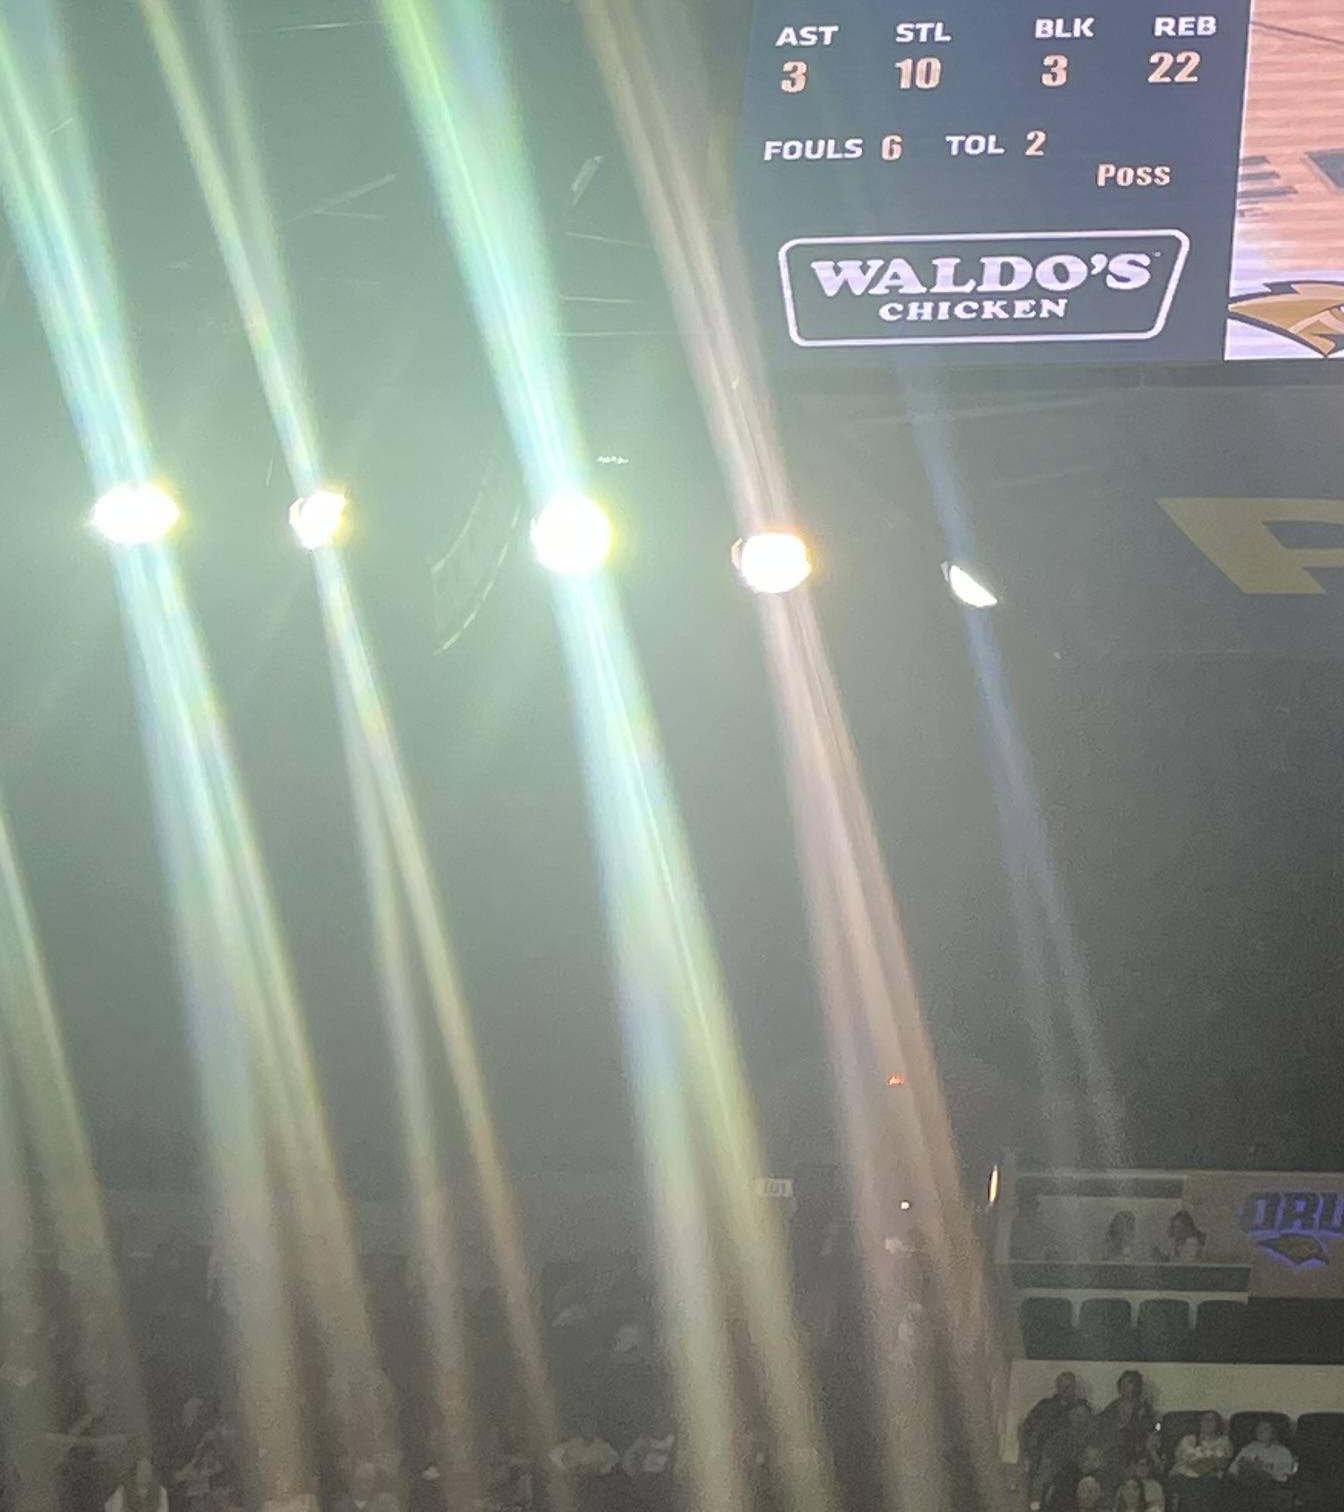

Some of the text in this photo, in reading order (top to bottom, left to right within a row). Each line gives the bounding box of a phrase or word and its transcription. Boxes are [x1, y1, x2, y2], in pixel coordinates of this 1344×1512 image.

[775, 16, 1216, 46] AST STL BLK REB
[781, 51, 1200, 92] 3 10 3 22
[763, 131, 1046, 160] FOULS 6 TOL 2
[811, 253, 1152, 297] WALDO'S
[879, 298, 1068, 321] CHICKEN
